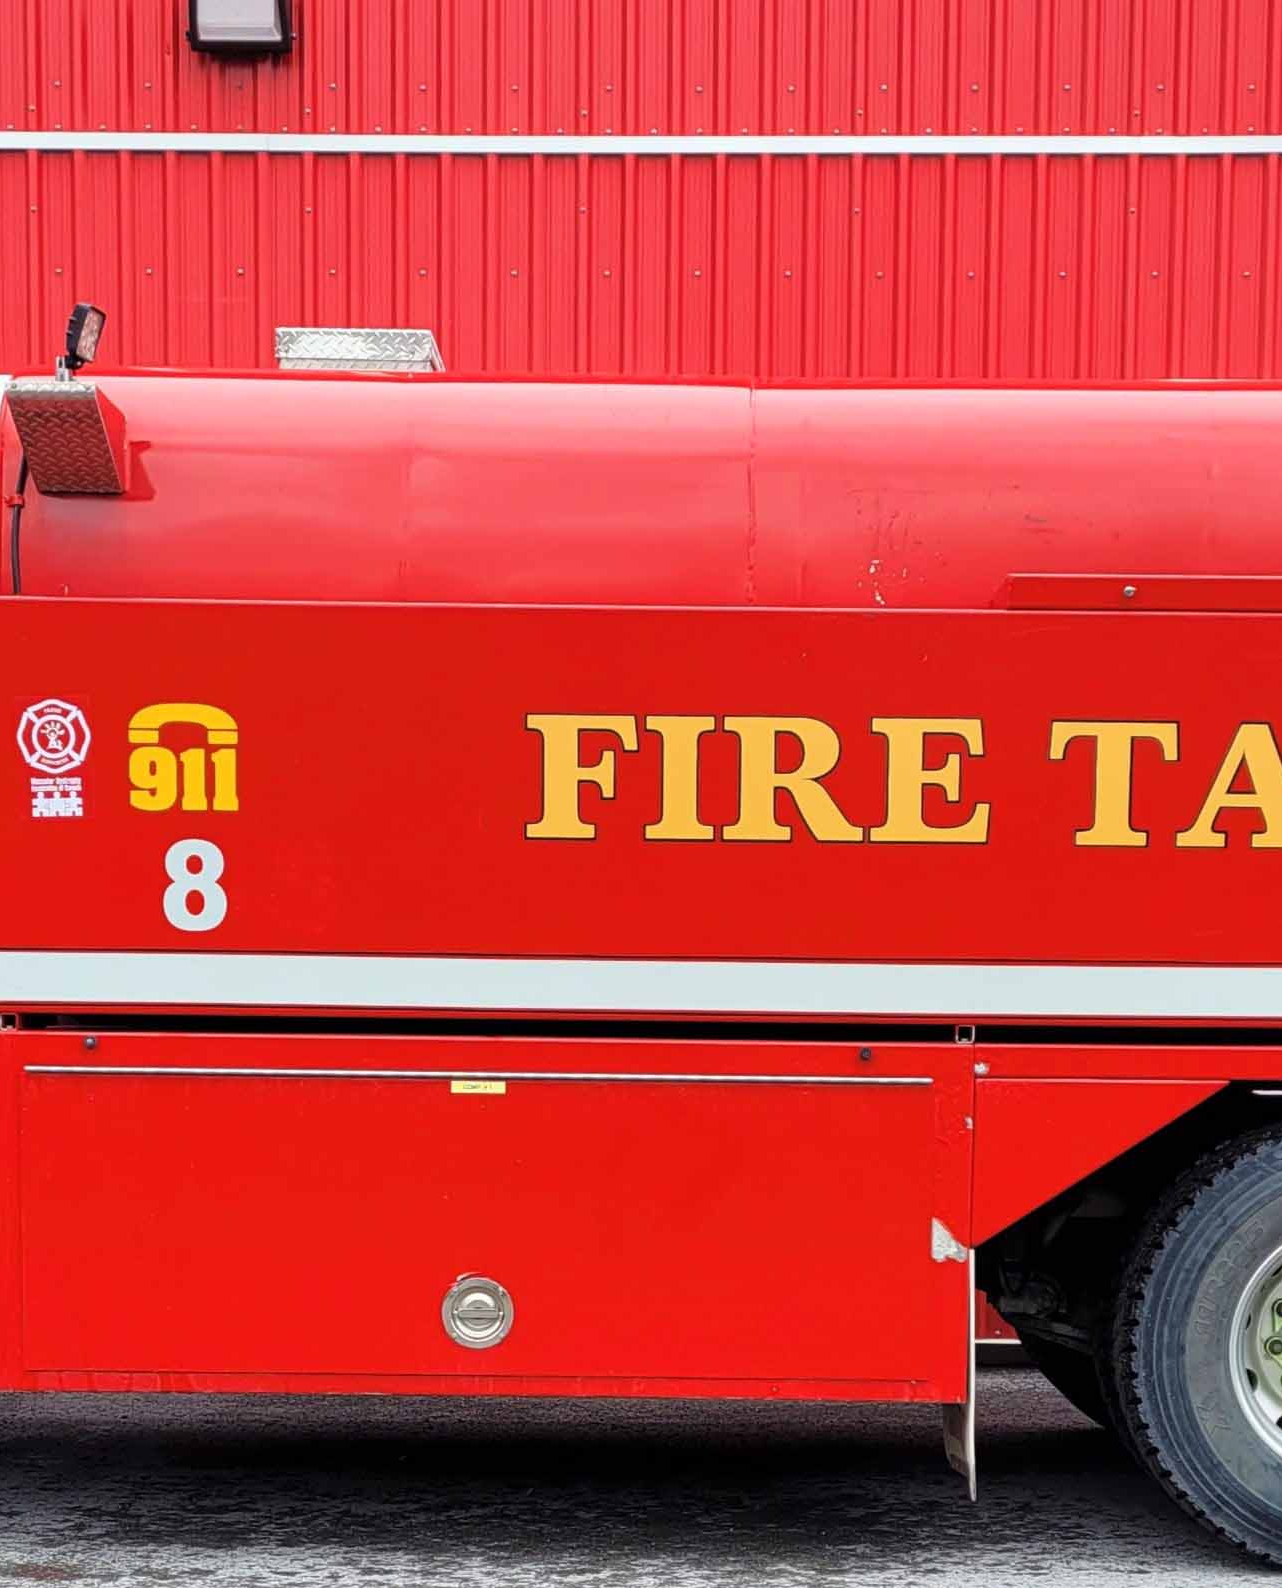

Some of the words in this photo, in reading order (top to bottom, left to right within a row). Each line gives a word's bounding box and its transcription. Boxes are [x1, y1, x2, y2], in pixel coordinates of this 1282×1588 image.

[128, 745, 239, 812] 911
[524, 713, 991, 845] FIRE
[162, 837, 229, 932] 8
